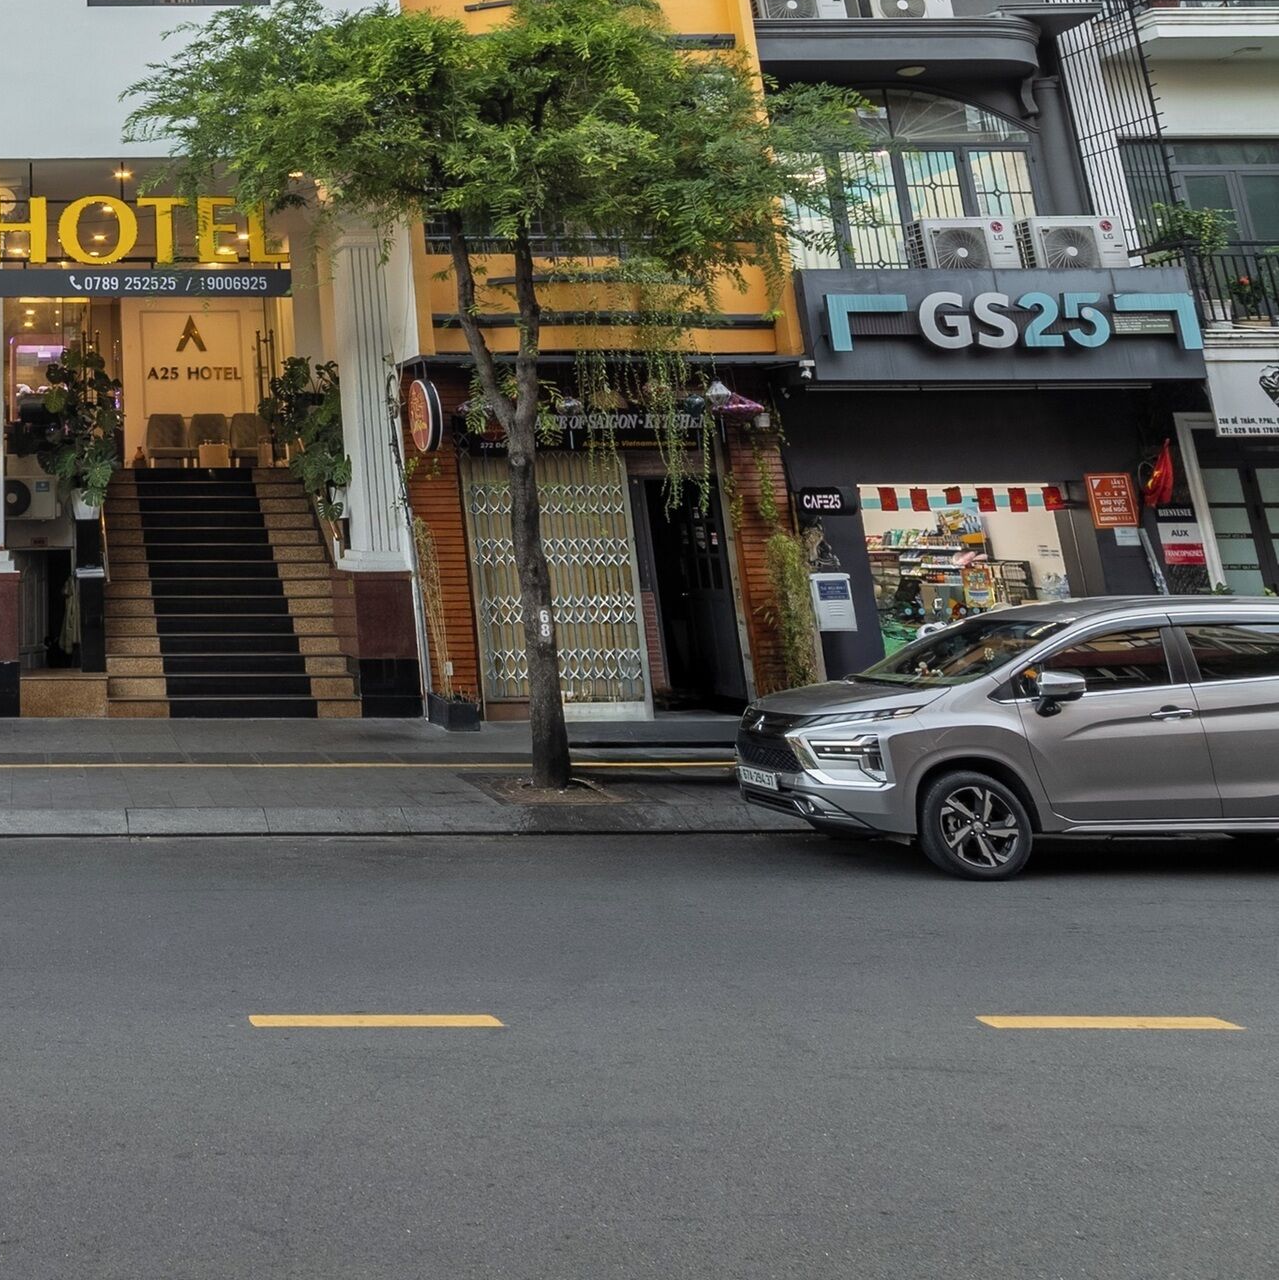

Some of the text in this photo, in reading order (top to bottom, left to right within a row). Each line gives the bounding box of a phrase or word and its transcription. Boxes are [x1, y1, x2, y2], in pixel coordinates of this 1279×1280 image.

[84, 277, 119, 290] 0789
[125, 277, 176, 290] 252525
[919, 291, 1111, 349] GS25
[147, 366, 242, 381] A25 HOTEL
[803, 494, 841, 509] CAFE25
[1171, 529, 1189, 537] AUX
